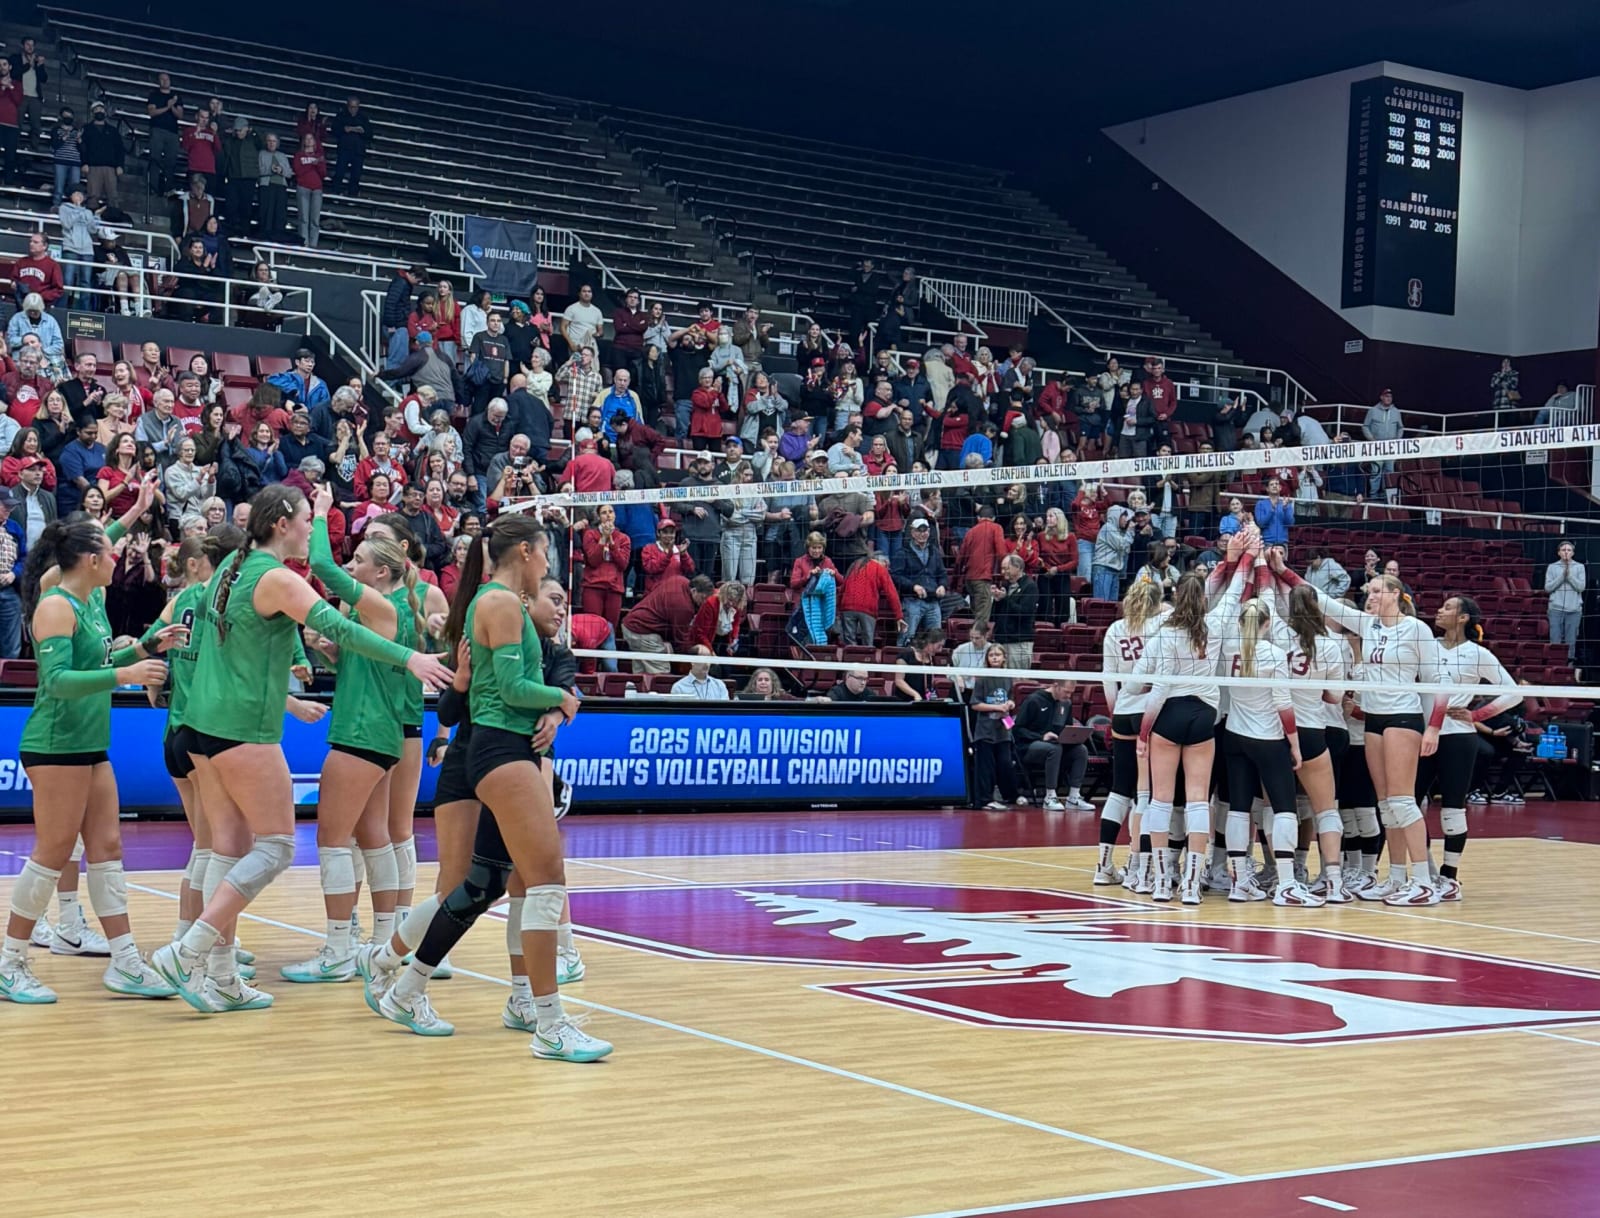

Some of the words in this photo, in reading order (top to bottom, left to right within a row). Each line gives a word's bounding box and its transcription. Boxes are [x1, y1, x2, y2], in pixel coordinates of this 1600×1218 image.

[1384, 96, 1461, 119] CHAMPIONSHIPS
[1388, 112, 1406, 124] 1920
[1415, 117, 1431, 129] 1921
[1439, 122, 1456, 134] 1936
[1388, 126, 1405, 138] 1937
[1413, 131, 1431, 143] 1938
[1438, 136, 1456, 148] 1942
[1386, 153, 1404, 165] 2001
[1411, 157, 1430, 170] 2004
[1413, 144, 1430, 156] 1999
[1436, 148, 1456, 160] 2000
[1380, 199, 1457, 220] CHAMPIONSHIPS
[1385, 214, 1401, 226] 1991
[1409, 218, 1427, 230] 2012
[1434, 222, 1452, 234] 2015
[484, 247, 532, 263] VOLLEYBALL
[660, 487, 688, 499] STANFORD
[689, 486, 719, 498] ATHLETICS
[757, 481, 788, 494] STANFORD
[790, 479, 824, 493] ATHLETICS
[866, 474, 900, 488] STANFORD
[904, 472, 942, 486] ATHLETICS
[991, 467, 1031, 480] STANFORD
[1034, 464, 1077, 478] ATHLETICS
[1134, 456, 1180, 472] STANFORD
[1184, 452, 1235, 468] ATHLETICS
[1301, 444, 1356, 461] STANFORD
[1361, 439, 1420, 457] ATHLETICS
[1500, 428, 1564, 447] STANFORD
[1119, 636, 1144, 661] 22
[629, 727, 690, 755] 2025
[695, 728, 752, 755] NCAA
[757, 728, 849, 755] DIVISION
[854, 729, 862, 754] I
[656, 758, 781, 785] VOLLEYBALL
[787, 758, 943, 784] CHAMPIONSHIP
